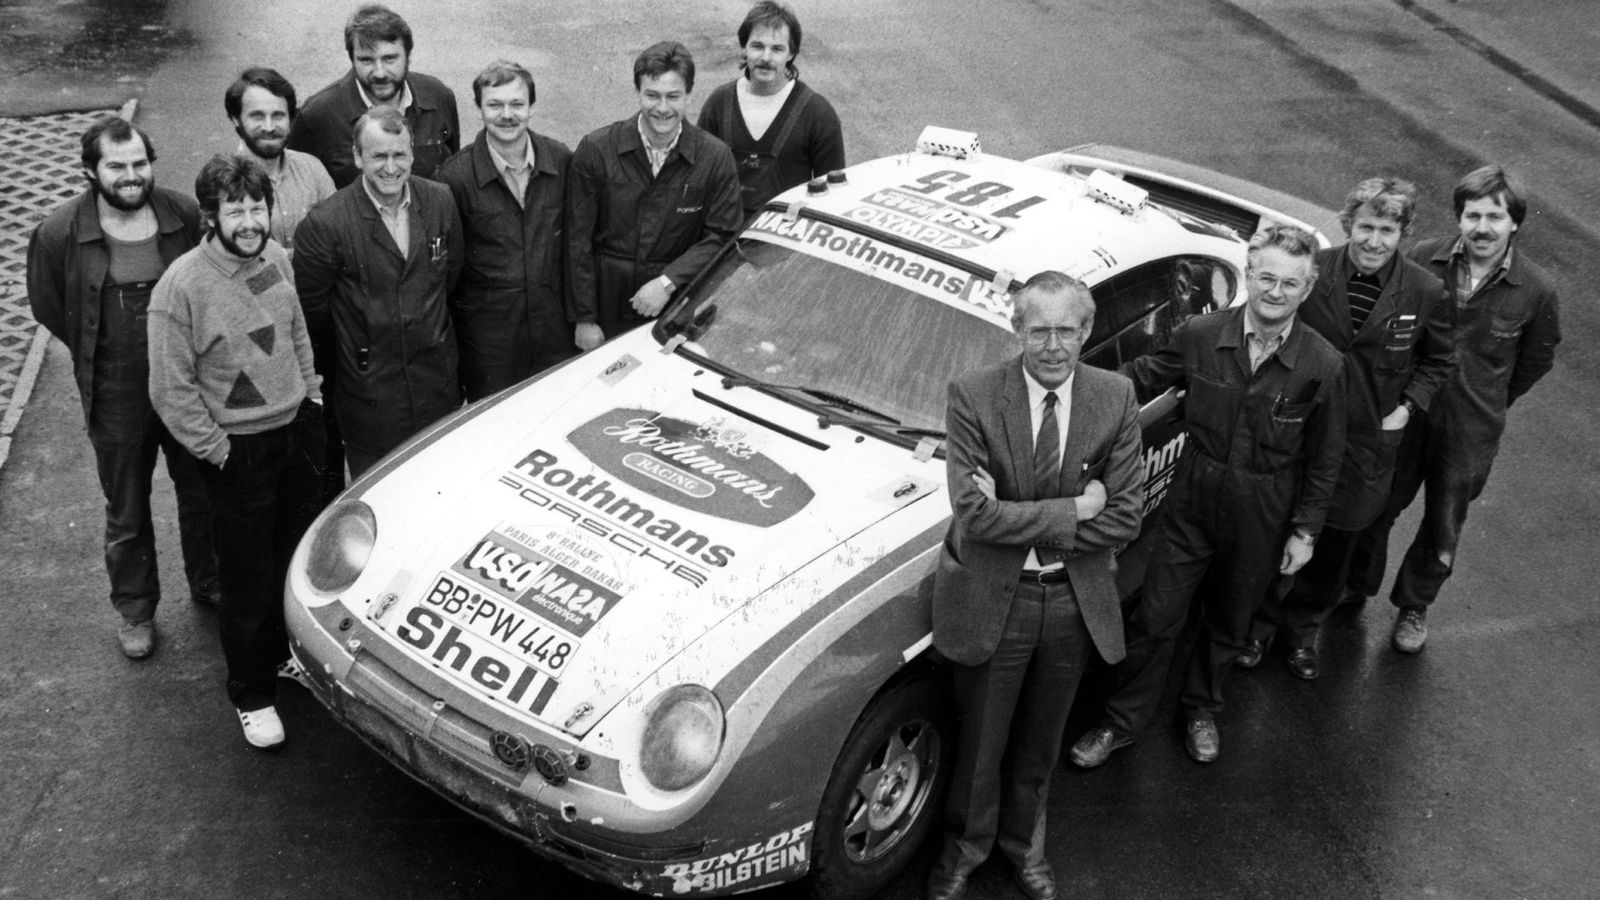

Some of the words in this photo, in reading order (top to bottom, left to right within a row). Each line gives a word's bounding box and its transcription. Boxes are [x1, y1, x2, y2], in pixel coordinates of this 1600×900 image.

[900, 170, 1047, 219] 185
[807, 223, 965, 295] Rothmans
[603, 413, 783, 508] Rothmans
[636, 458, 700, 490] RACING
[498, 476, 708, 588] PORSCHE
[514, 449, 736, 567] Rothmans
[504, 526, 539, 547] PARIS
[541, 545, 580, 568] ALGER
[581, 565, 624, 590] DAKAR
[559, 537, 604, 563] RALLYE
[397, 606, 559, 716] Shell
[518, 627, 571, 669] 448
[659, 821, 814, 877] DUNLOP
[699, 841, 806, 892] BILSTEIN
